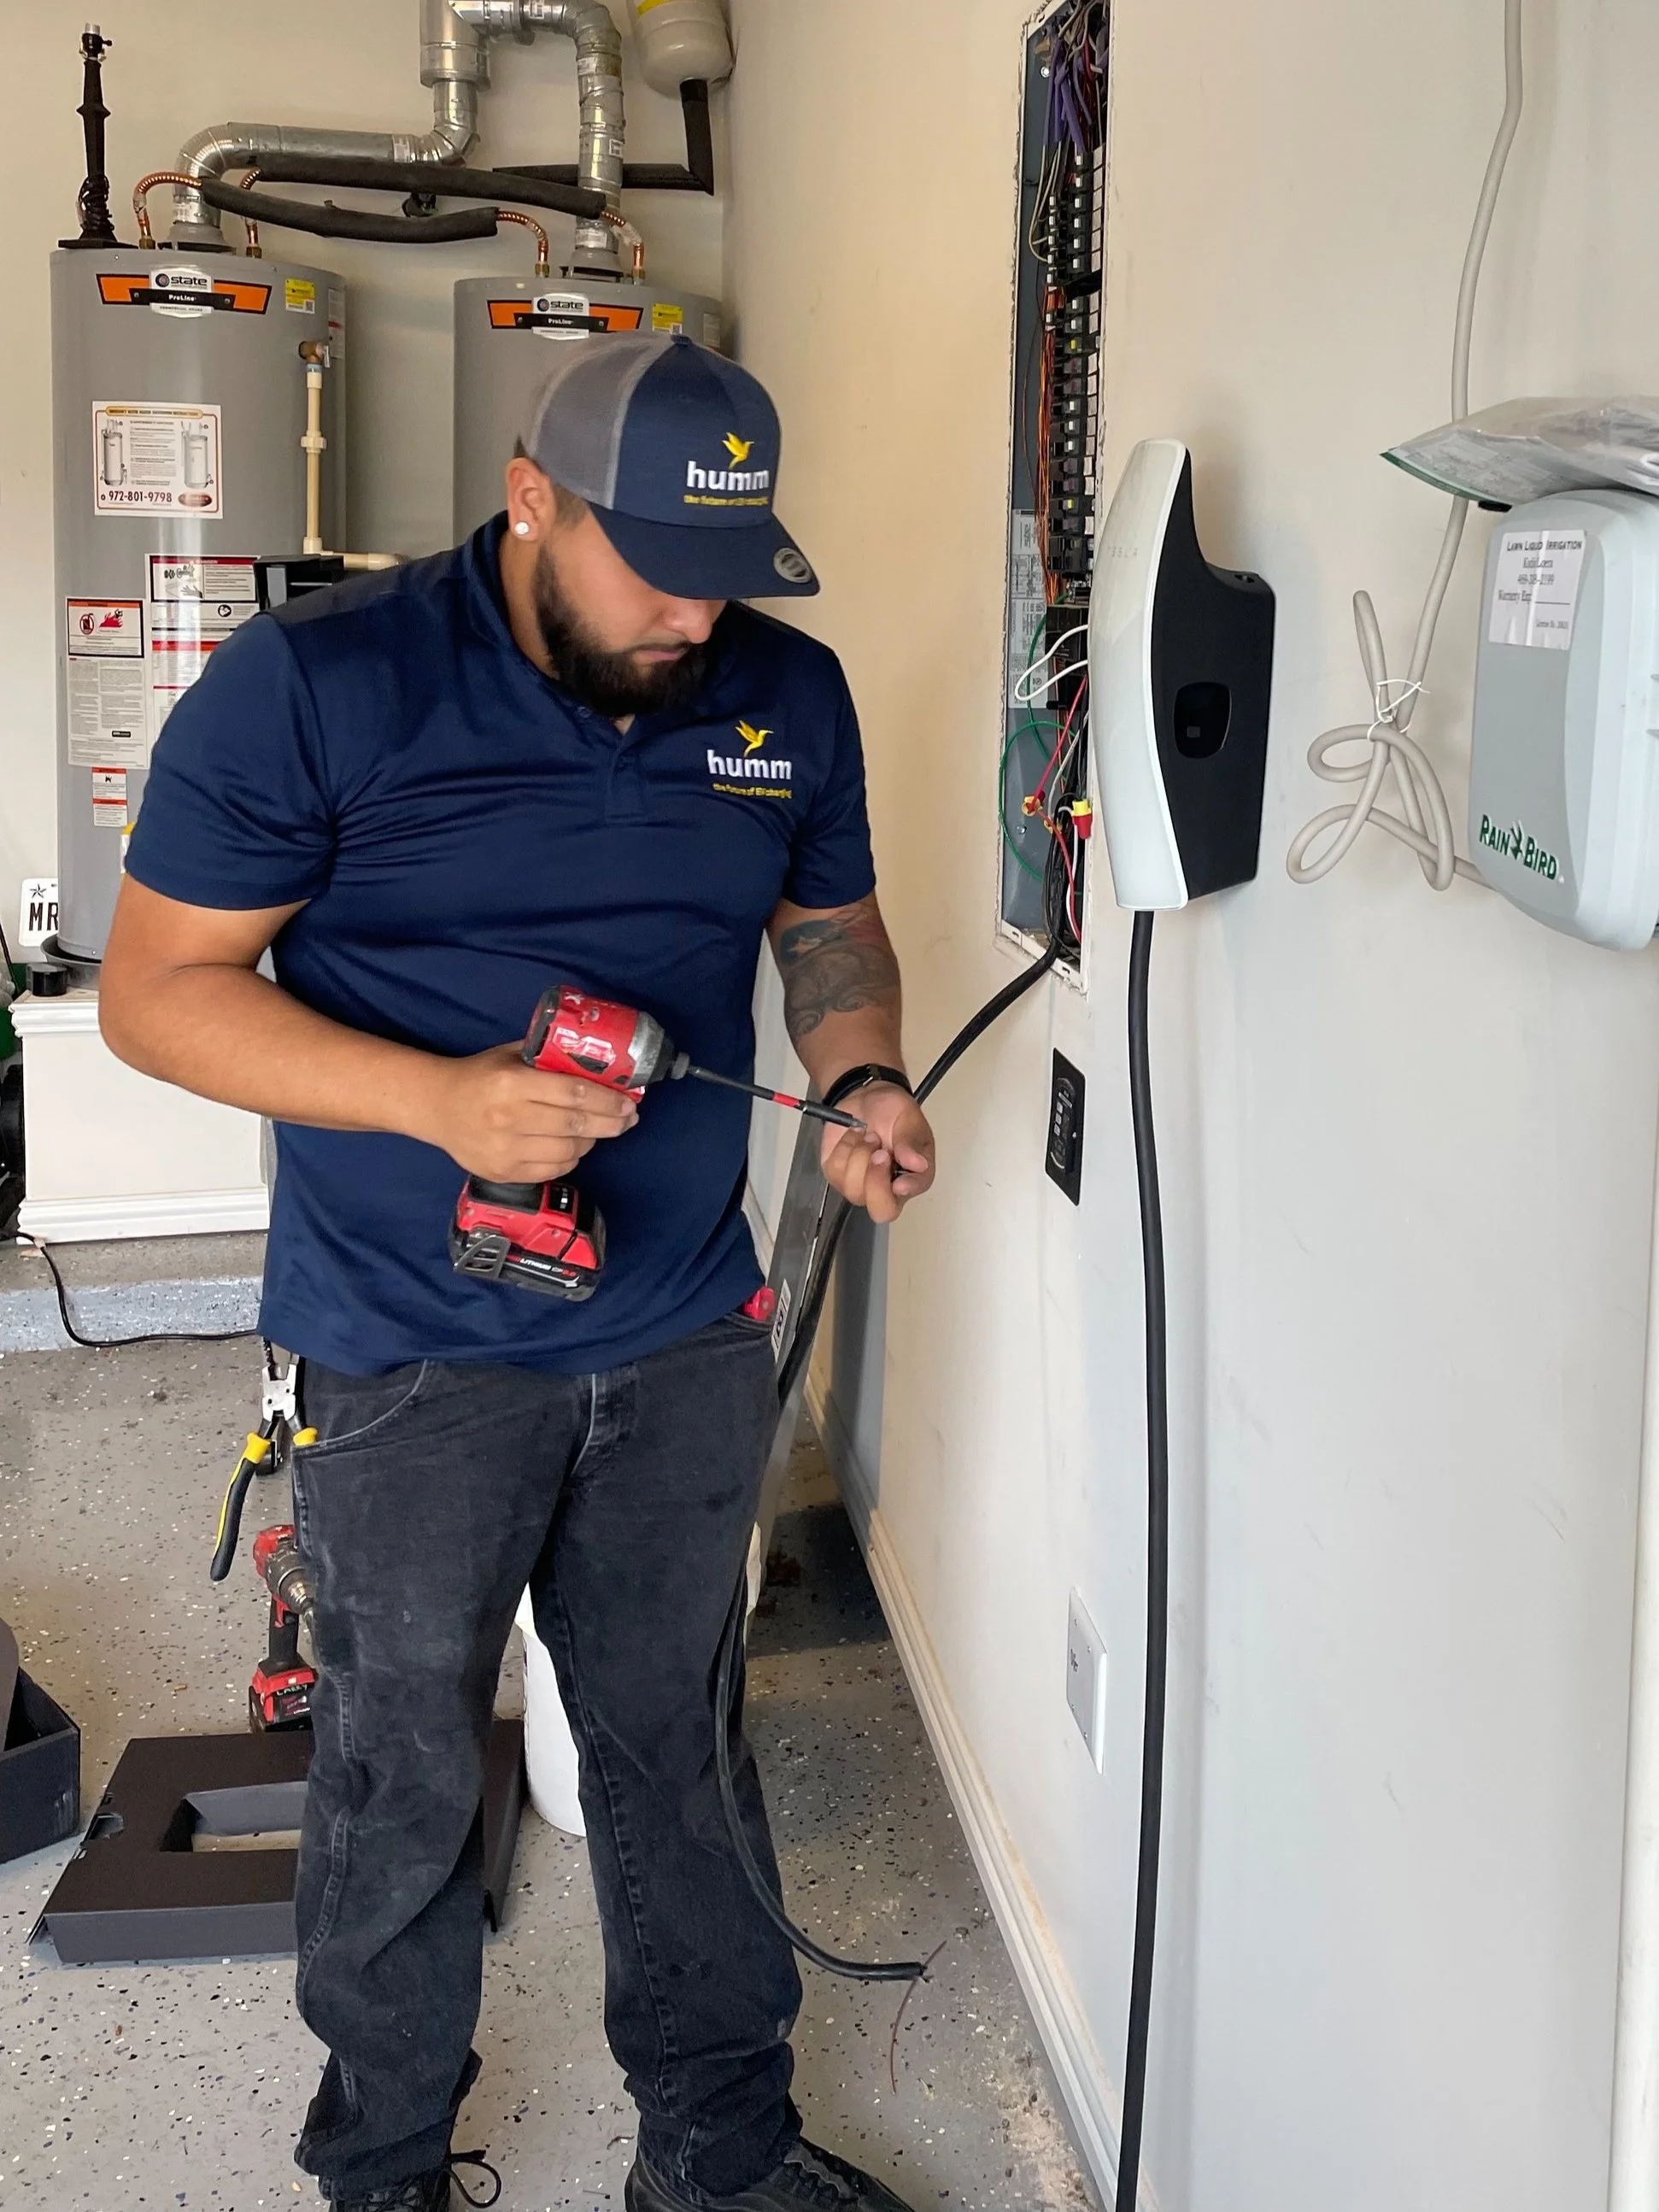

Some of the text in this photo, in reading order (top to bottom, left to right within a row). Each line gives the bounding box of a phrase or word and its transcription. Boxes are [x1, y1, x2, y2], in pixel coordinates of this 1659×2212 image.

[171, 275, 208, 285] state
[550, 301, 583, 309] state
[686, 460, 770, 491] humm
[108, 490, 173, 502] 972-801-9798
[706, 749, 792, 780] humm
[1480, 814, 1558, 881] RAIN BIRD
